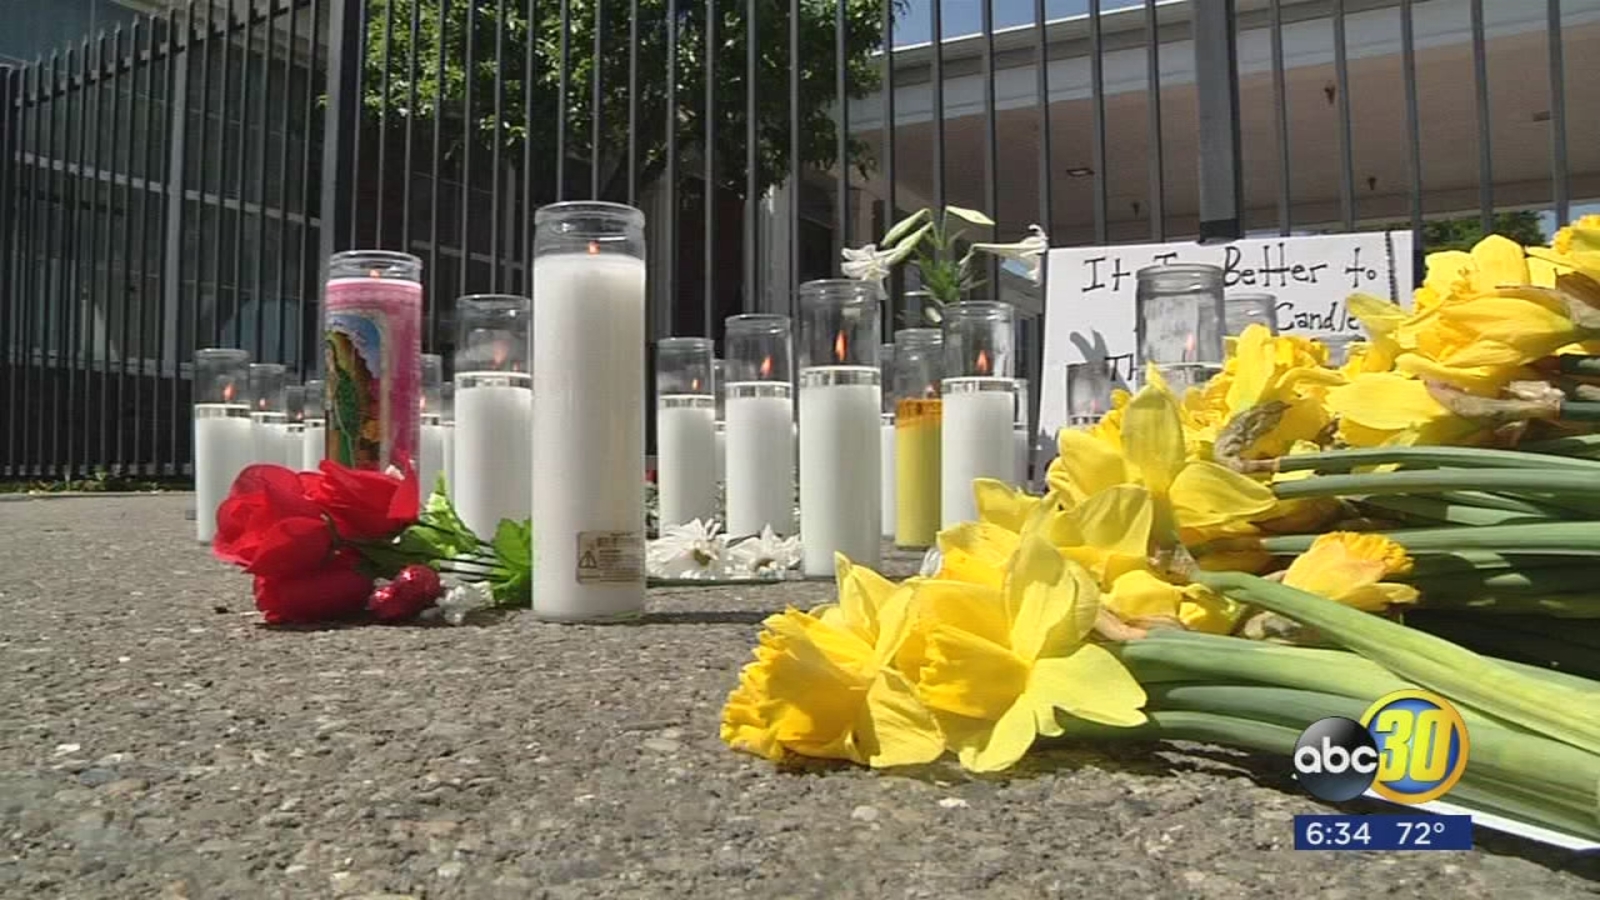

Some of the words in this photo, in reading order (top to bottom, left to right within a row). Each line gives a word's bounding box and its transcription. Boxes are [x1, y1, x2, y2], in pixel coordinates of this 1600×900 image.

[1082, 257, 1131, 292] It
[1223, 242, 1328, 287] Better
[1345, 247, 1377, 288] to
[1275, 301, 1361, 332] Candle
